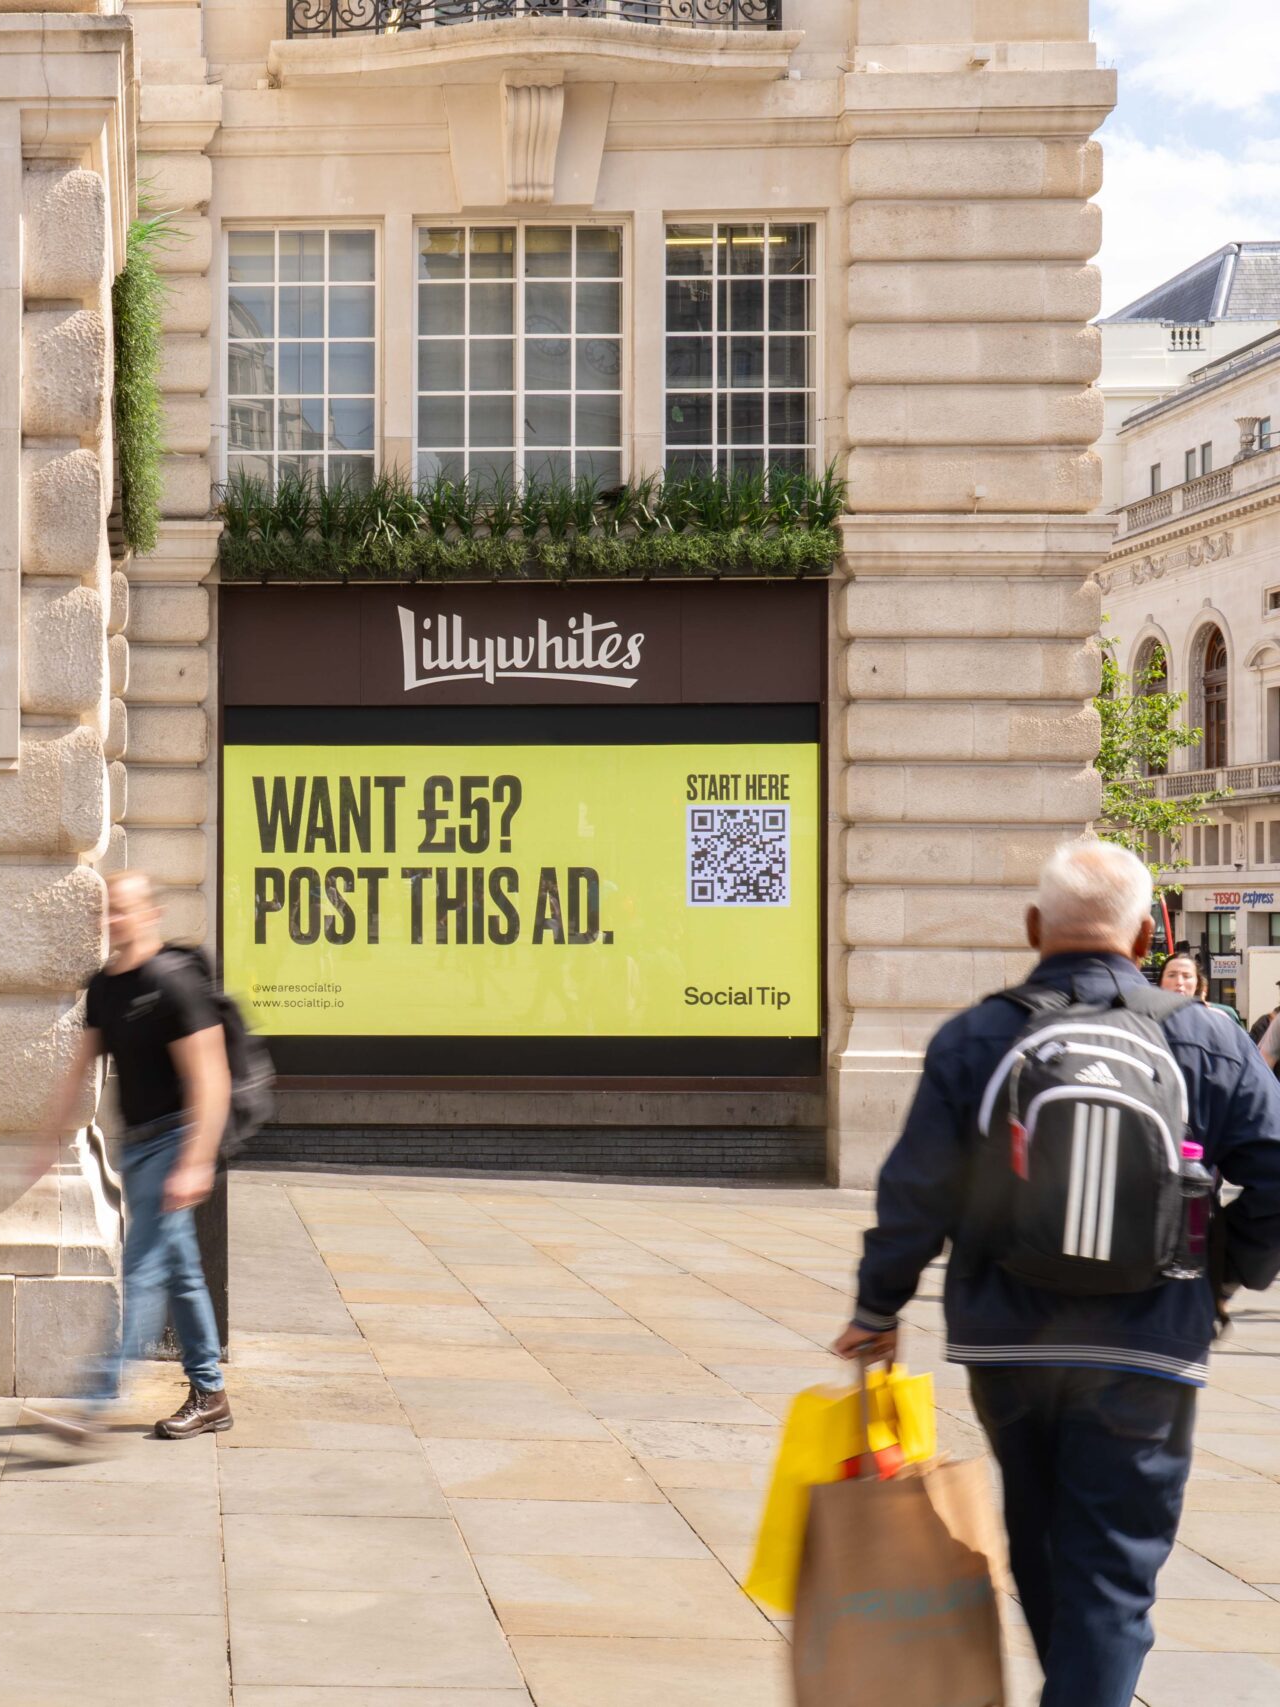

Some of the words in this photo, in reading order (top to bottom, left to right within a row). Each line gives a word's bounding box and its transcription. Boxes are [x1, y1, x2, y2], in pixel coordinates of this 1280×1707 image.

[398, 606, 644, 691] Lillywhites
[687, 774, 741, 800] START
[746, 774, 790, 800] HERE
[252, 776, 405, 853] WANT
[418, 775, 522, 853] £5?
[255, 867, 388, 945] POST
[401, 867, 520, 945] THIS
[532, 867, 613, 944] AD.
[1214, 892, 1240, 904] TESCO
[1242, 891, 1274, 908] express
[252, 983, 342, 994] @wearesocialtip
[685, 987, 752, 1005] Social
[757, 987, 790, 1010] Tip
[252, 998, 345, 1010] www.socialtip.io
